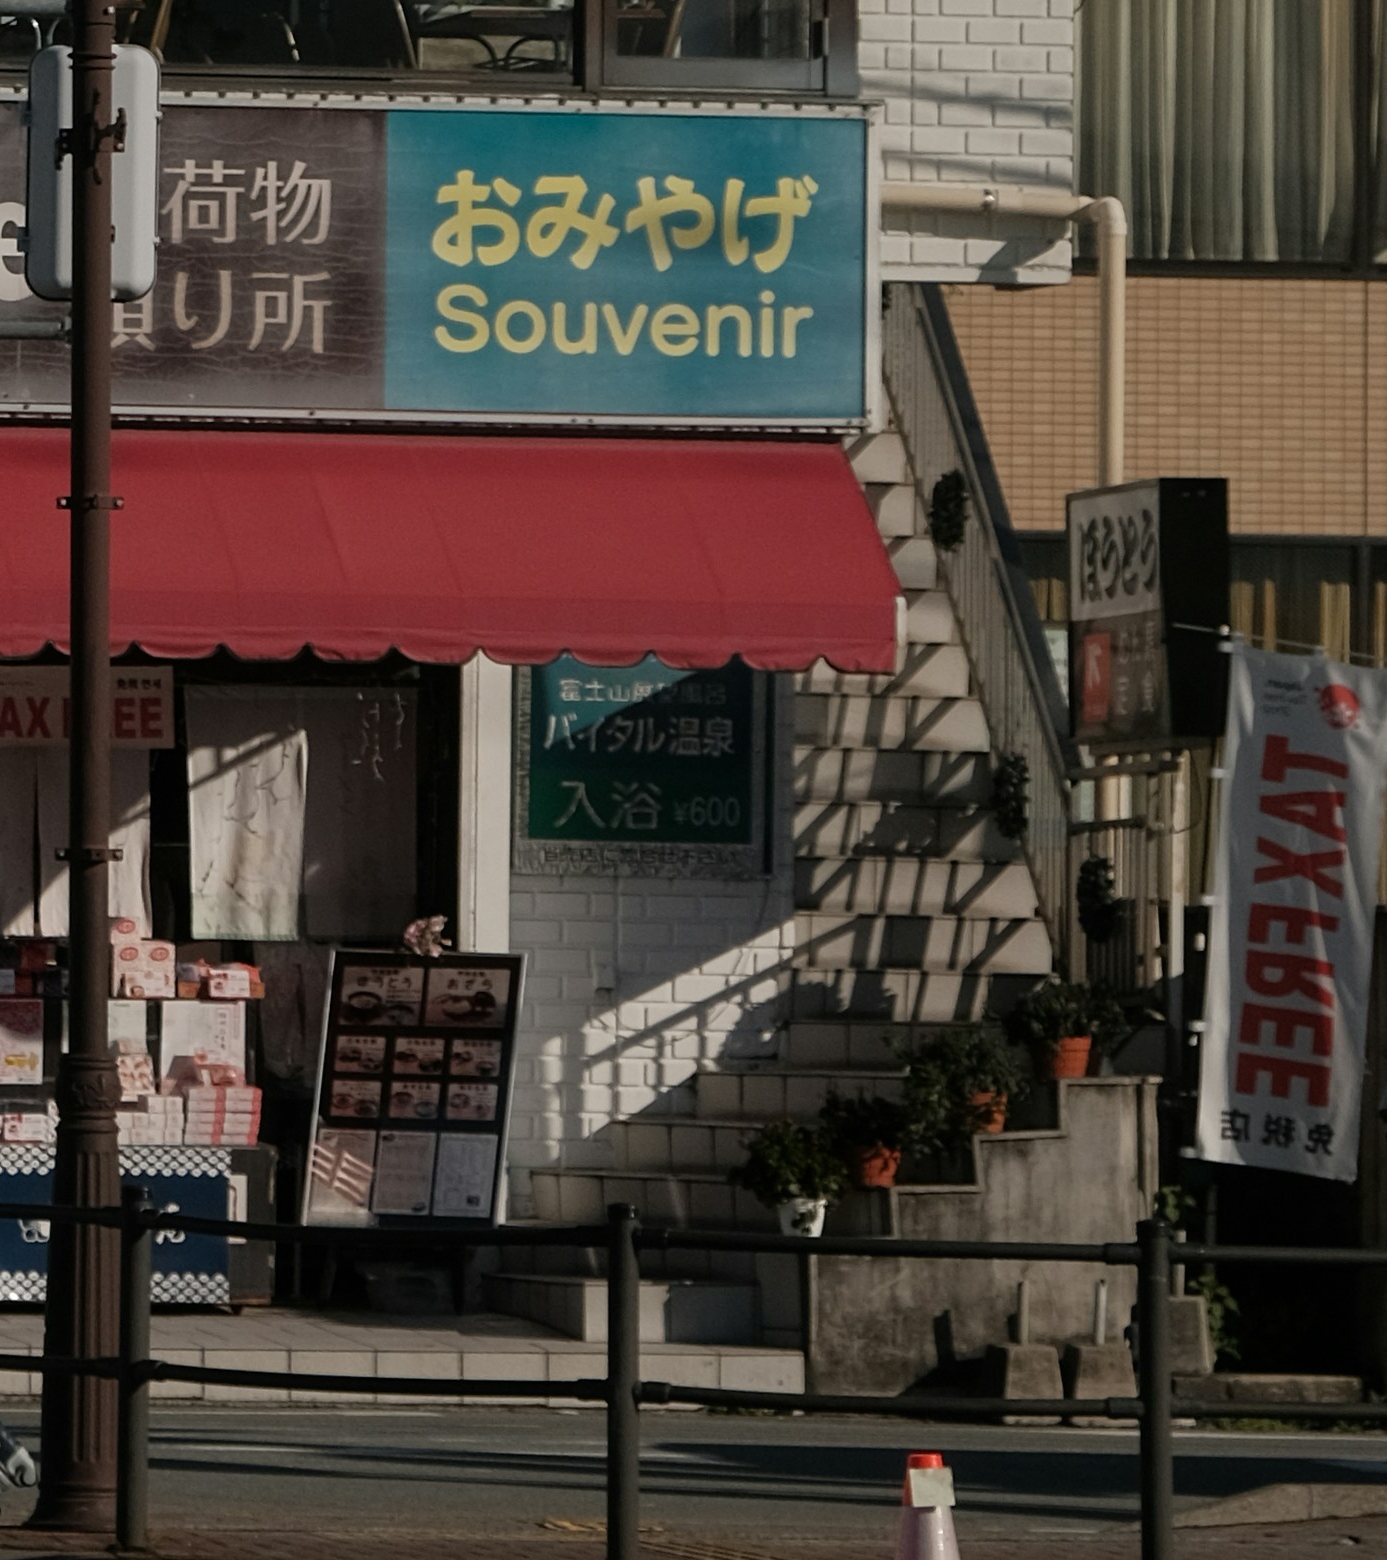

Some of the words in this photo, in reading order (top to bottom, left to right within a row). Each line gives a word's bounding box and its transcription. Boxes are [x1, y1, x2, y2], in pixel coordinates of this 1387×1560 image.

[431, 168, 820, 273] おみやげ
[434, 283, 814, 359] Souvenir
[1077, 508, 1159, 603] ほうとう
[63, 696, 164, 739] EE
[543, 712, 735, 757] バイタル温泉
[553, 780, 662, 830] 入浴
[673, 796, 741, 827] ¥600
